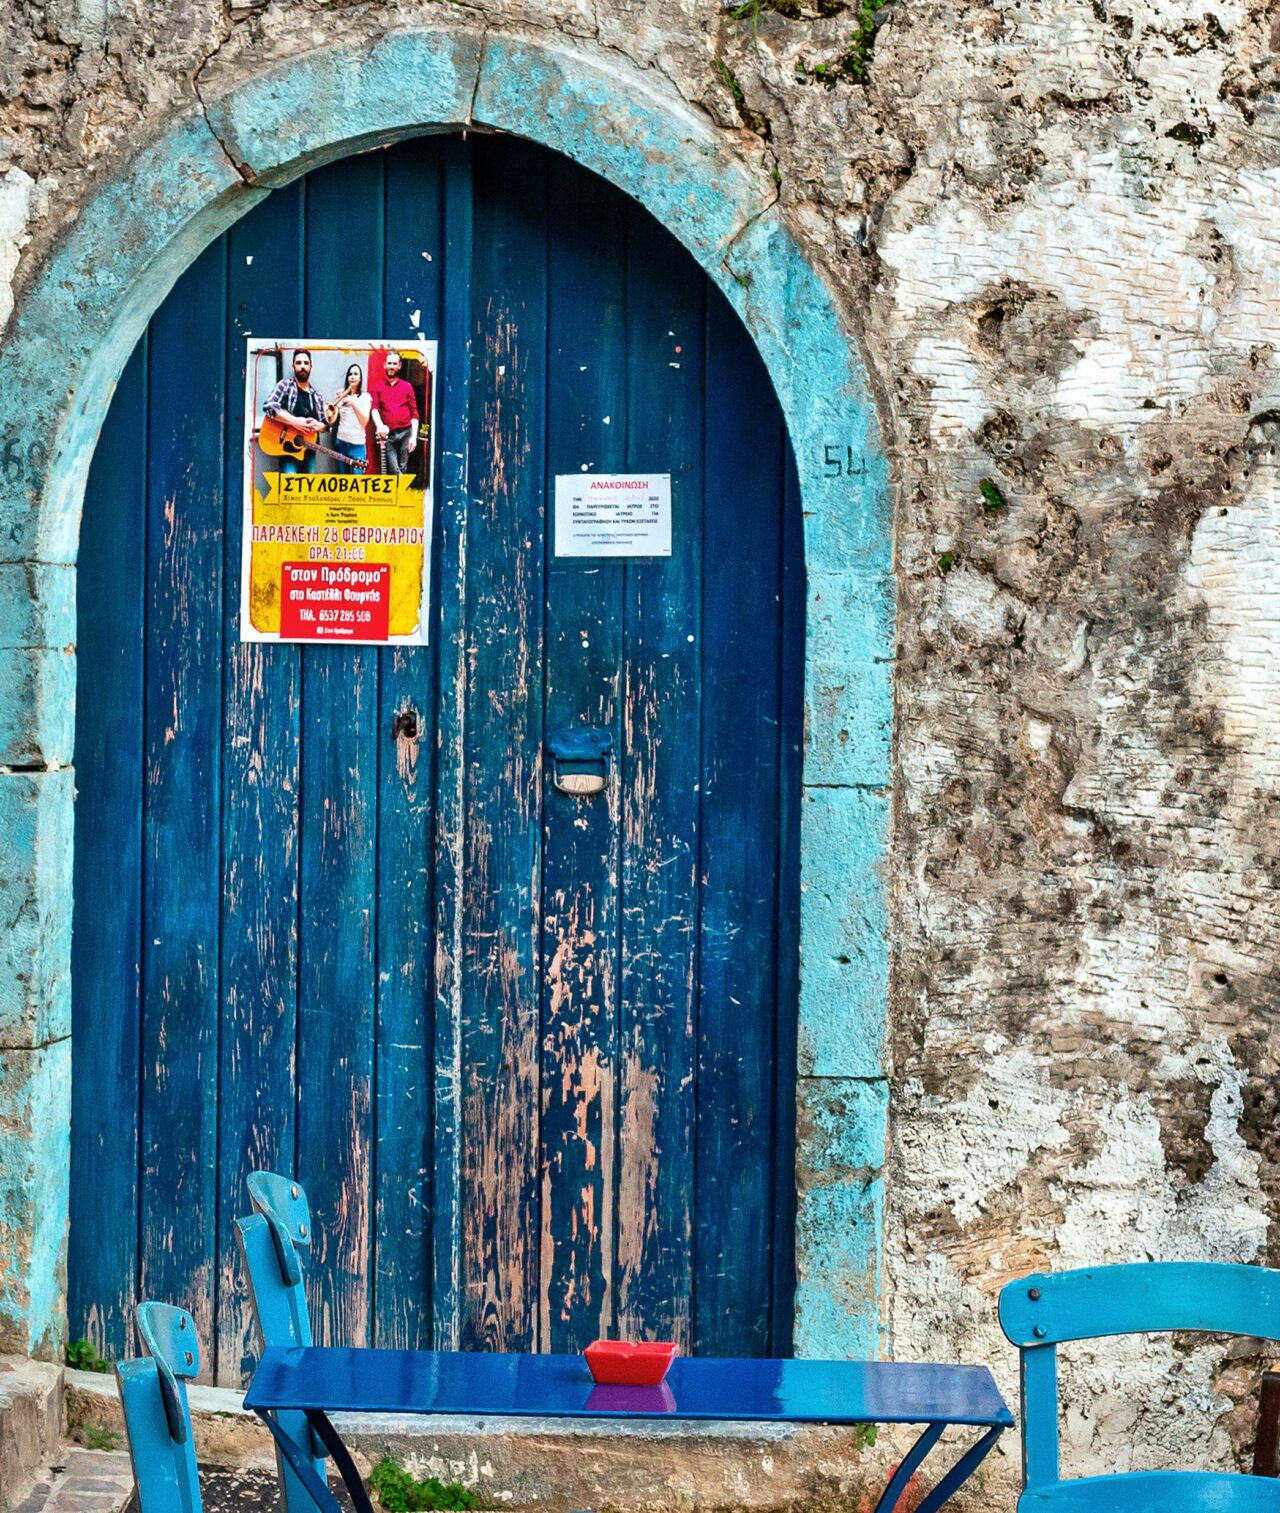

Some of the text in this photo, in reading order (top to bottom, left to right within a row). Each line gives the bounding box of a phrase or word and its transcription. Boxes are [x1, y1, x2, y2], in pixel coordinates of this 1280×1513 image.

[590, 481, 649, 489] ΑΝΑΚΟΙΝΩΣΗ
[252, 526, 424, 544] ΠΑΡΑΣΚΕΥΗ 28 ΦΕΒΡΟΥΑΡΙΟΥ
[309, 547, 333, 560] ΩΡΑ:
[289, 589, 305, 600] στο
[306, 587, 342, 601] Καστέλλι
[299, 608, 316, 621] ΤΗΛ.
